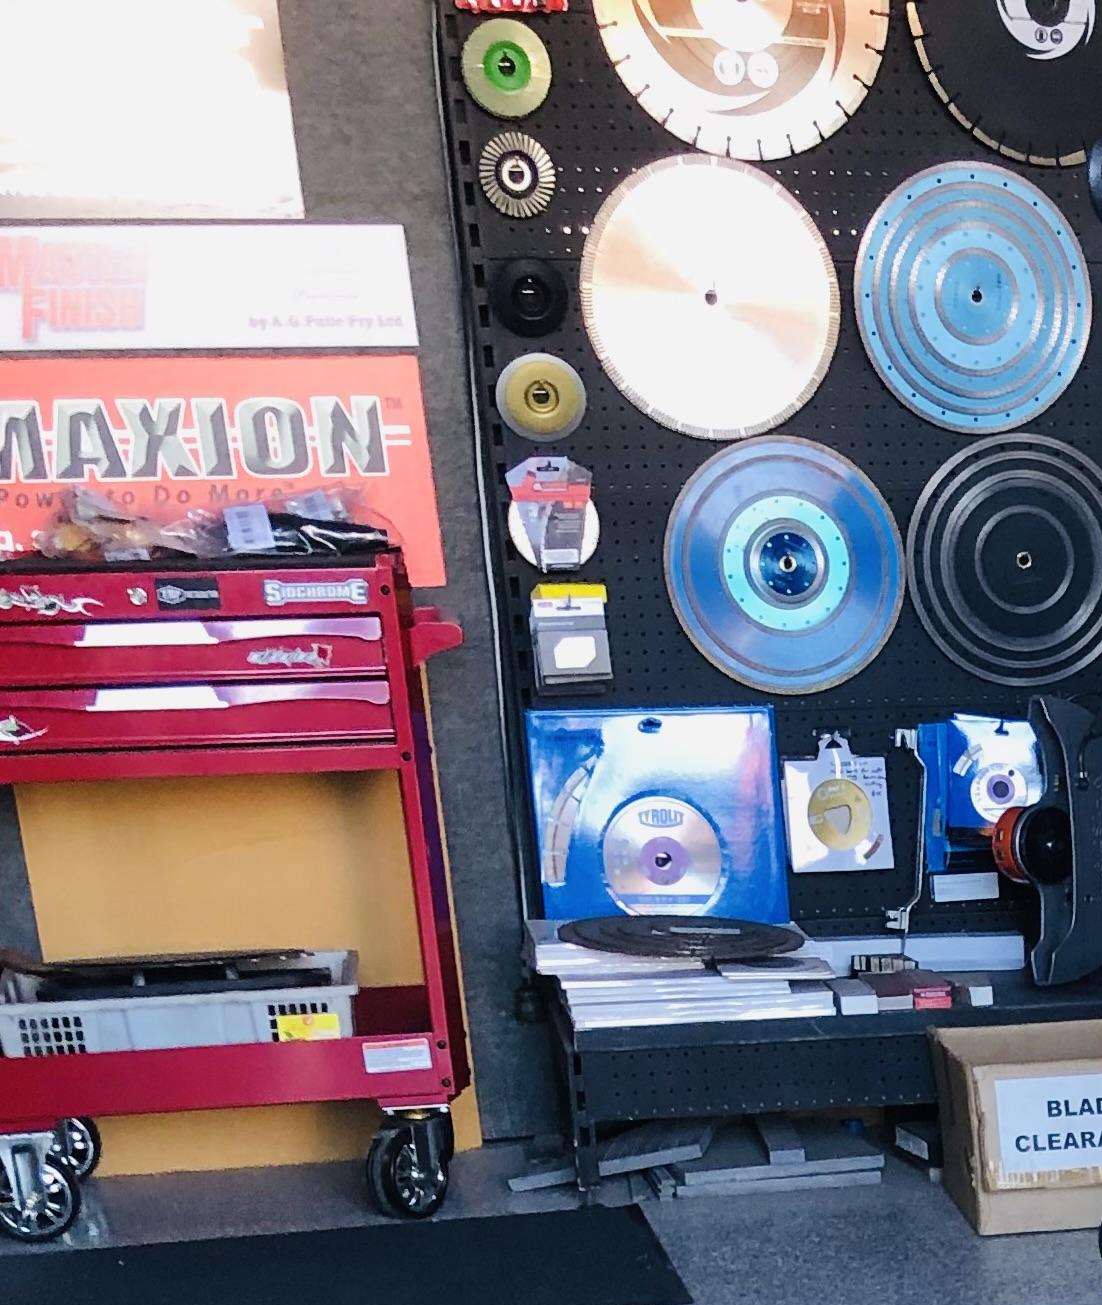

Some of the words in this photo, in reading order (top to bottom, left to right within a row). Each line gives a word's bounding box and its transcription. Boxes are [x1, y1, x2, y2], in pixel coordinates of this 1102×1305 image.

[0, 395, 391, 483] MAXION
[154, 486, 191, 505] Do
[208, 485, 283, 505] More
[638, 808, 684, 828] TYROLIT
